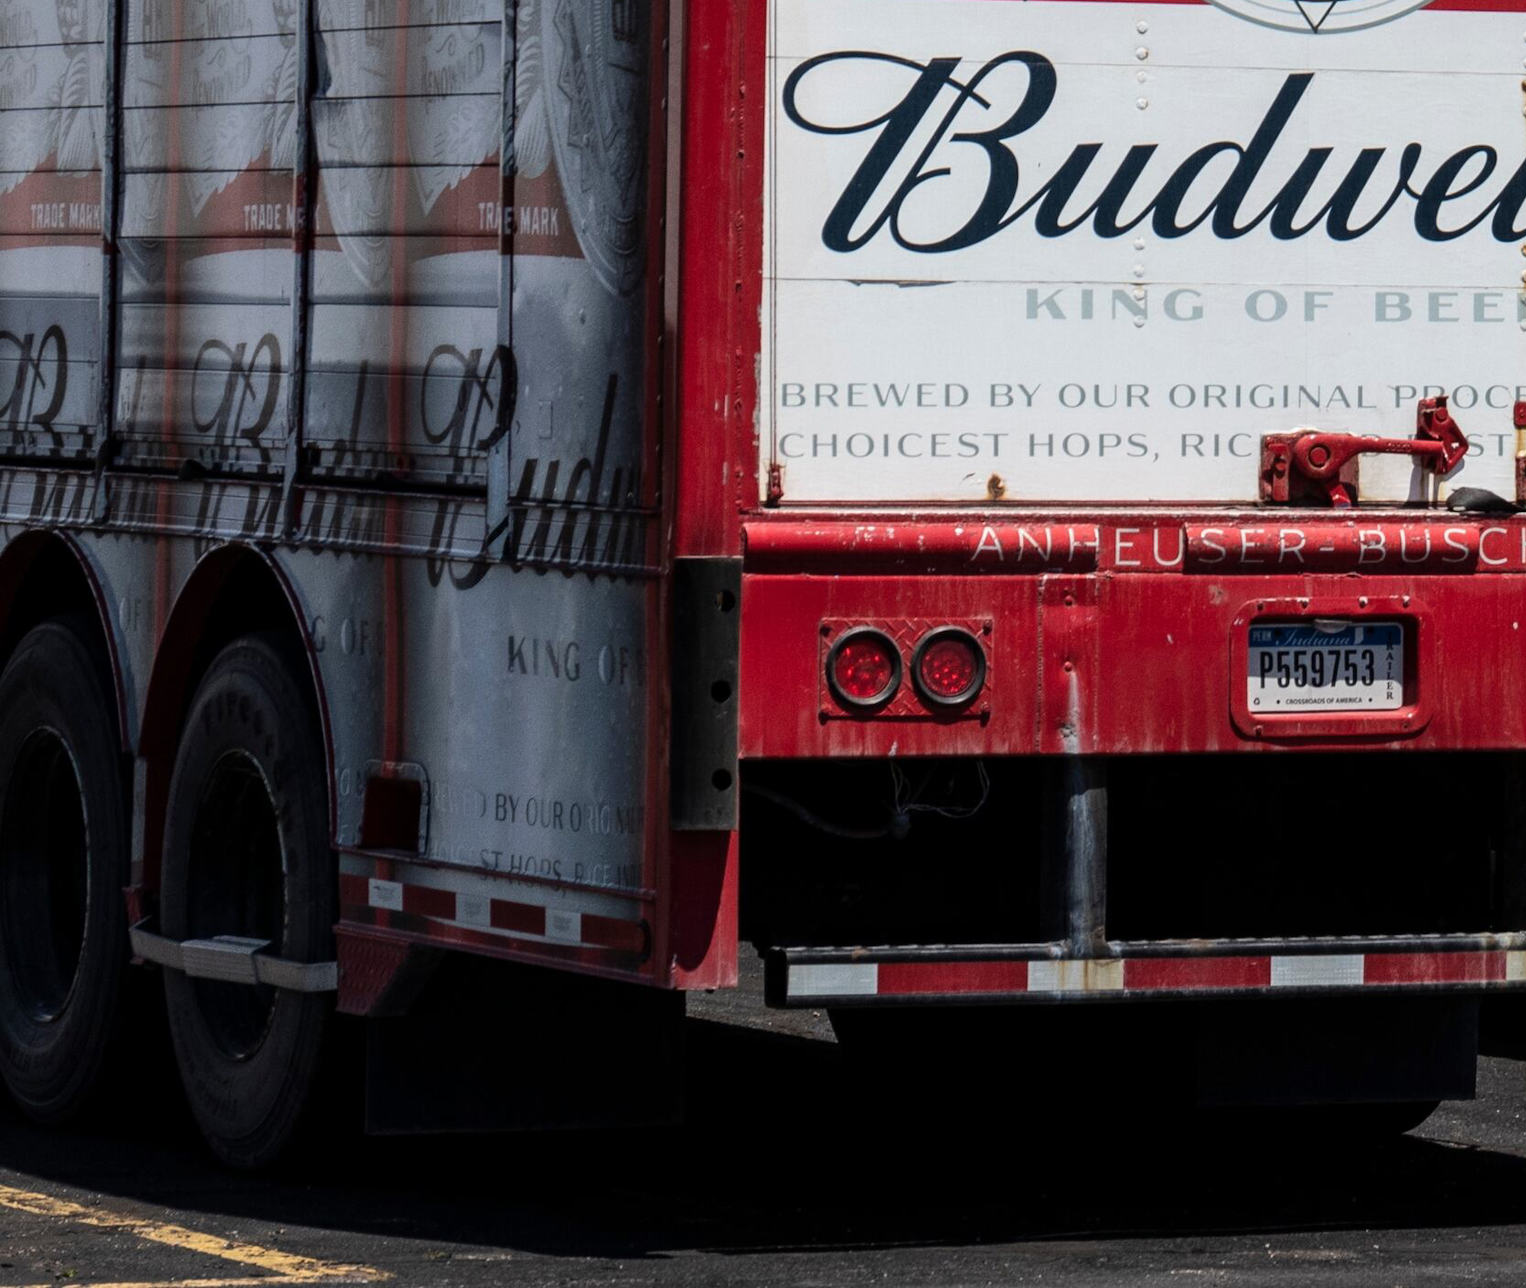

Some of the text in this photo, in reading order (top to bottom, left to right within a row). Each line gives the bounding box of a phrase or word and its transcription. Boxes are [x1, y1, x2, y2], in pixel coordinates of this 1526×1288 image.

[519, 205, 560, 237] MARK
[1026, 289, 1204, 323] KING
[1245, 289, 1334, 323] OF
[781, 382, 969, 409] BREWED
[989, 382, 1042, 409] BY
[1058, 383, 1151, 410] OUR
[1169, 383, 1377, 410] ORIGINAL
[779, 432, 1160, 463] CHOICEST HOPS,
[1277, 628, 1350, 646] Indiana
[507, 633, 580, 682] KING
[1259, 648, 1375, 689] P559753
